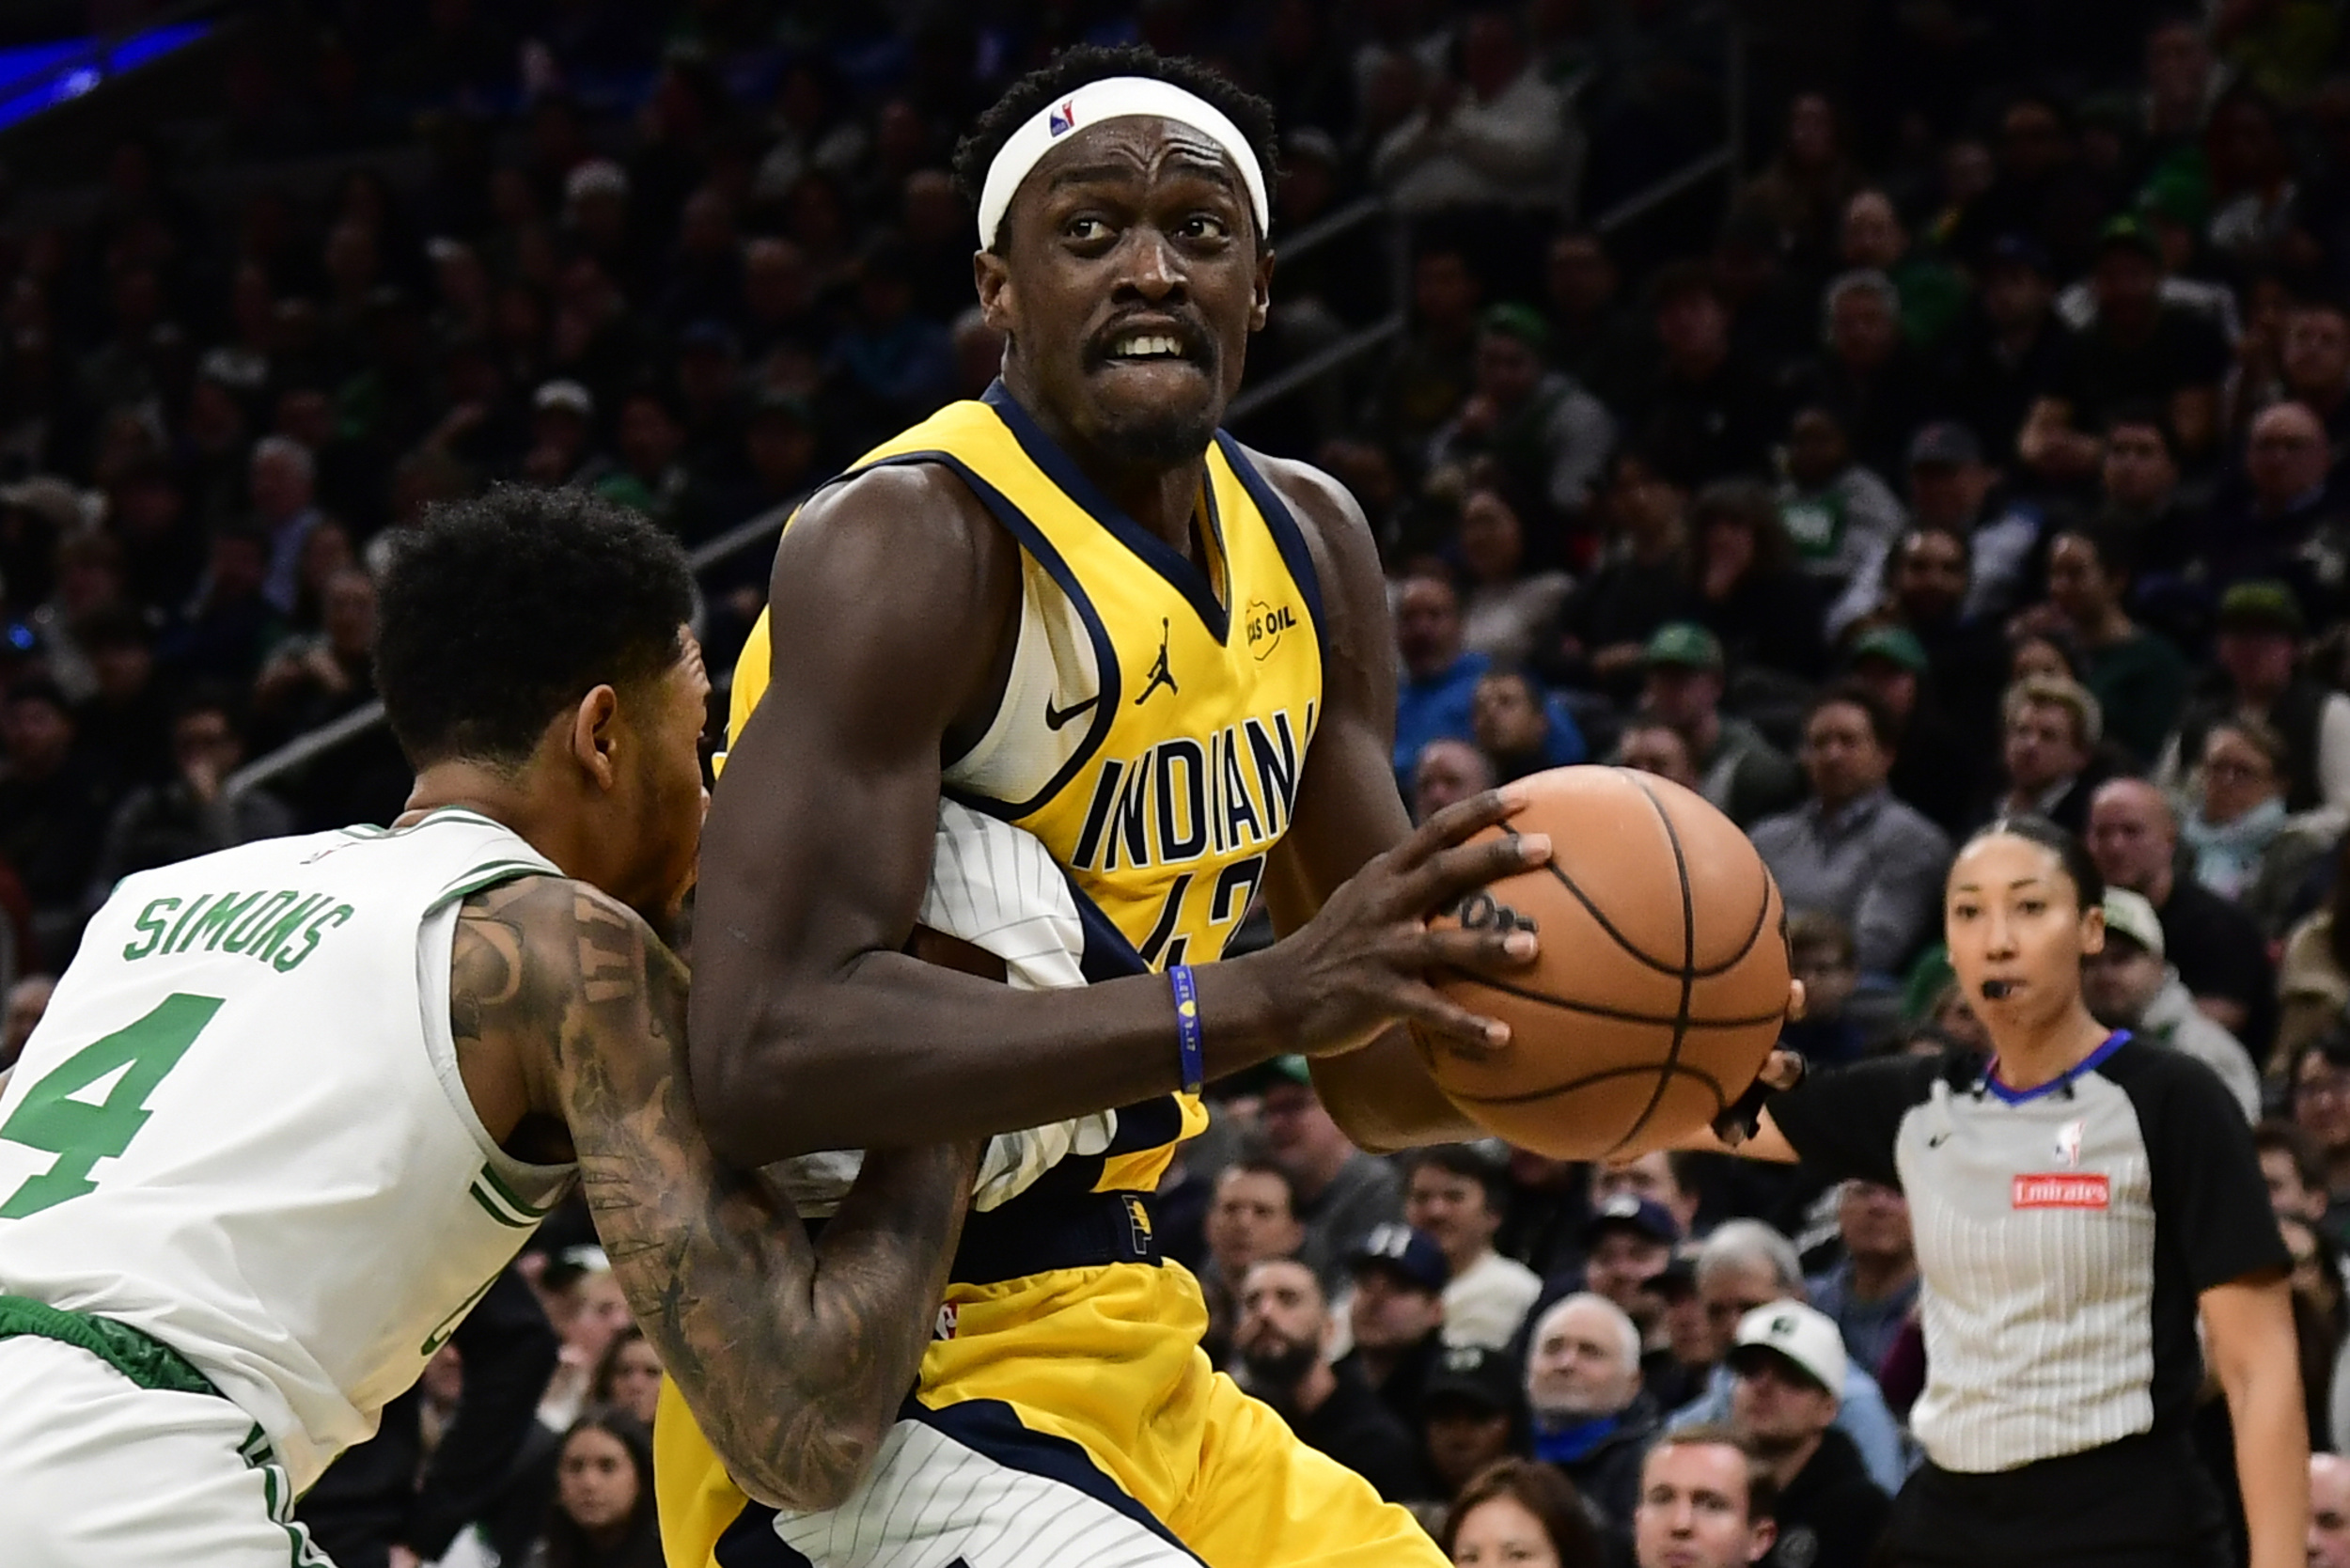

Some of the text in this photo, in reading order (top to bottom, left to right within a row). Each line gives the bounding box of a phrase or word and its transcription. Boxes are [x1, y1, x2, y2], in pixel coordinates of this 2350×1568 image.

[1265, 605, 1296, 635] OIL
[123, 890, 355, 973] SIMONS
[0, 993, 226, 1219] 4
[2014, 1180, 2107, 1202] Emirates
